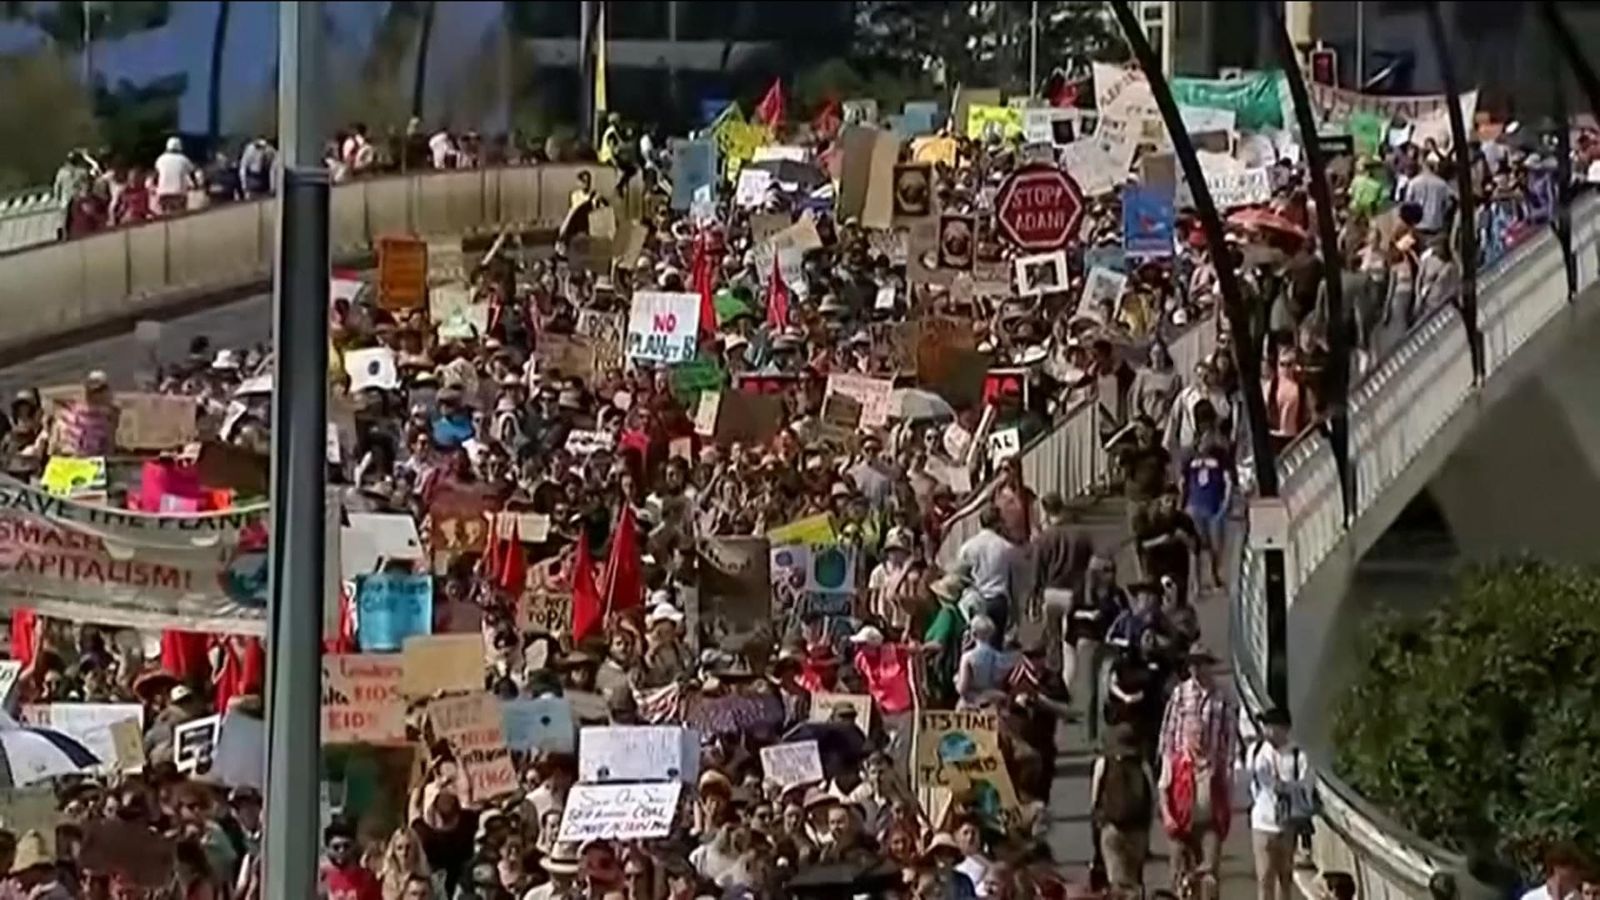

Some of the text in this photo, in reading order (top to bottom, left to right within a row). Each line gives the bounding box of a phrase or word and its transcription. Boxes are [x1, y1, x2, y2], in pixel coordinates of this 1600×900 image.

[1015, 210, 1065, 232] ADANI
[653, 313, 677, 333] NO
[683, 335, 695, 359] B
